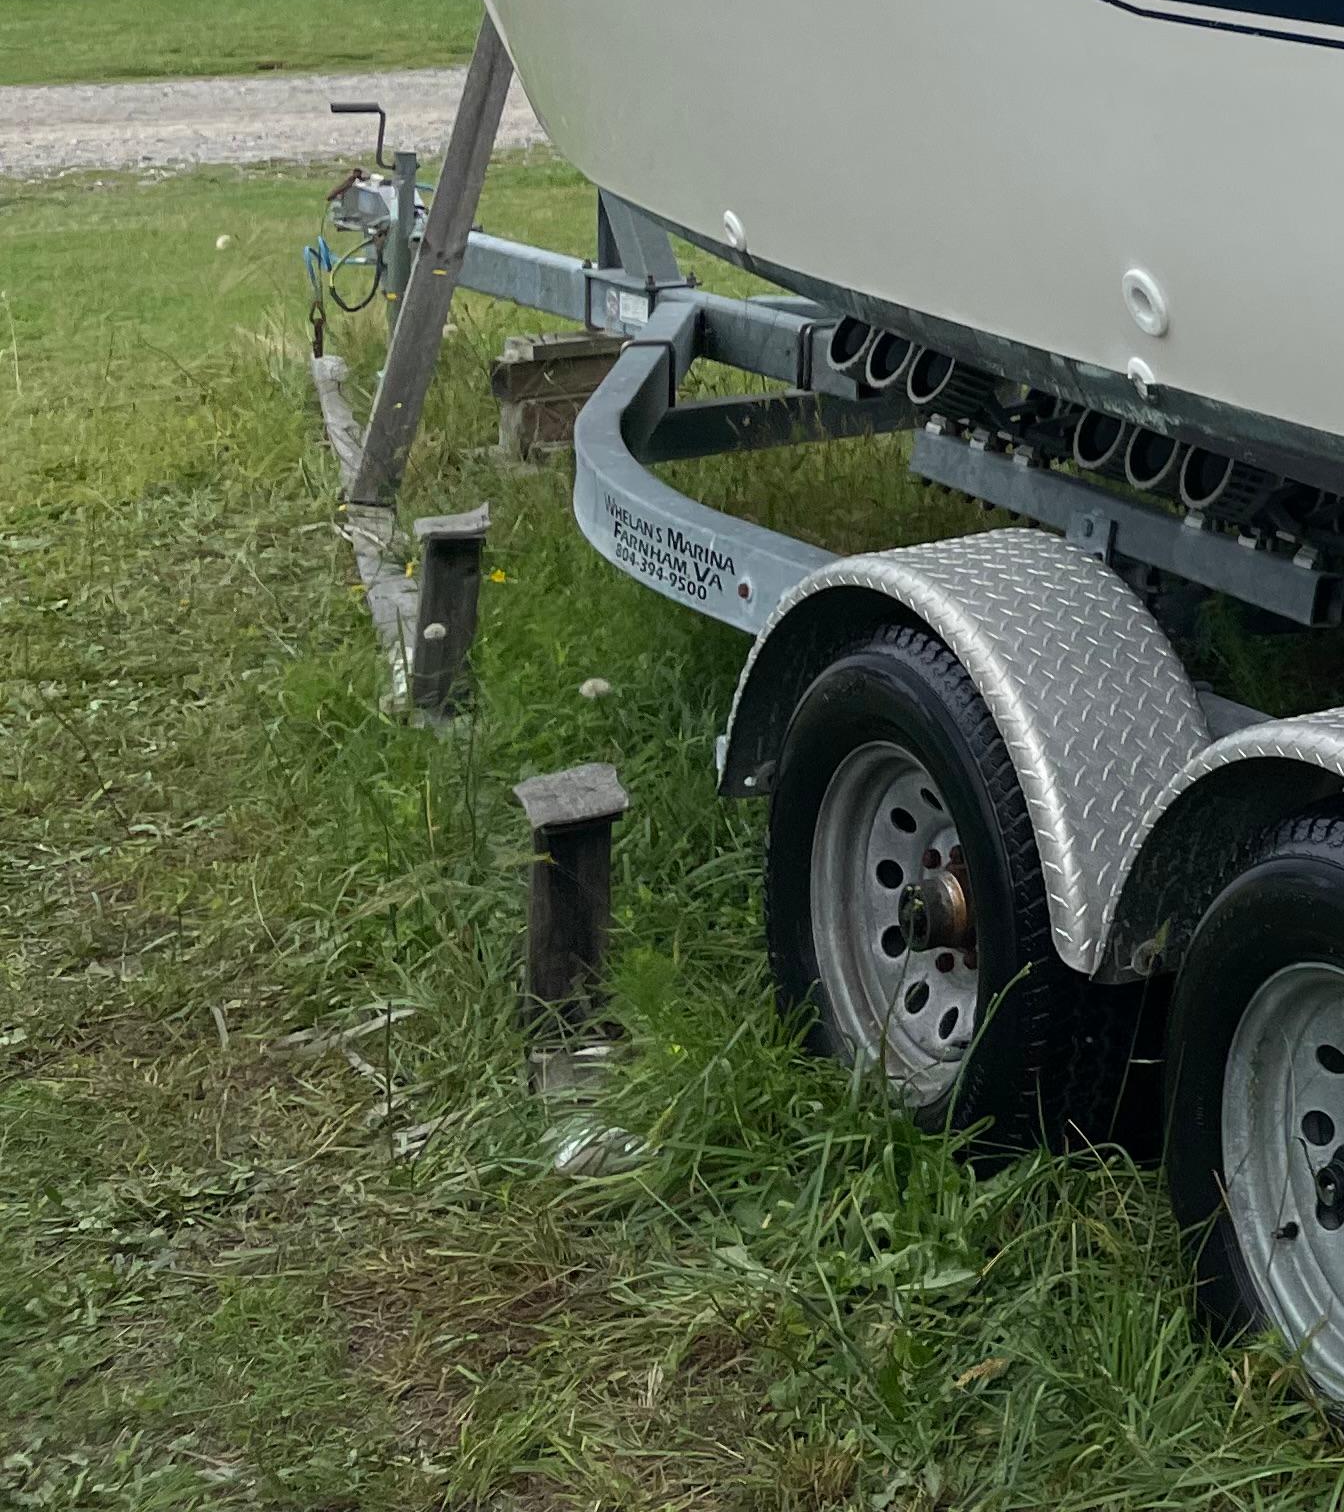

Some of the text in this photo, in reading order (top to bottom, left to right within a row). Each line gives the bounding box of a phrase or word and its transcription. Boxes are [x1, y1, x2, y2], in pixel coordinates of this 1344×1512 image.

[615, 541, 708, 601] 804-394-9500
[667, 527, 737, 577] MARINA
[693, 560, 723, 593] VA
